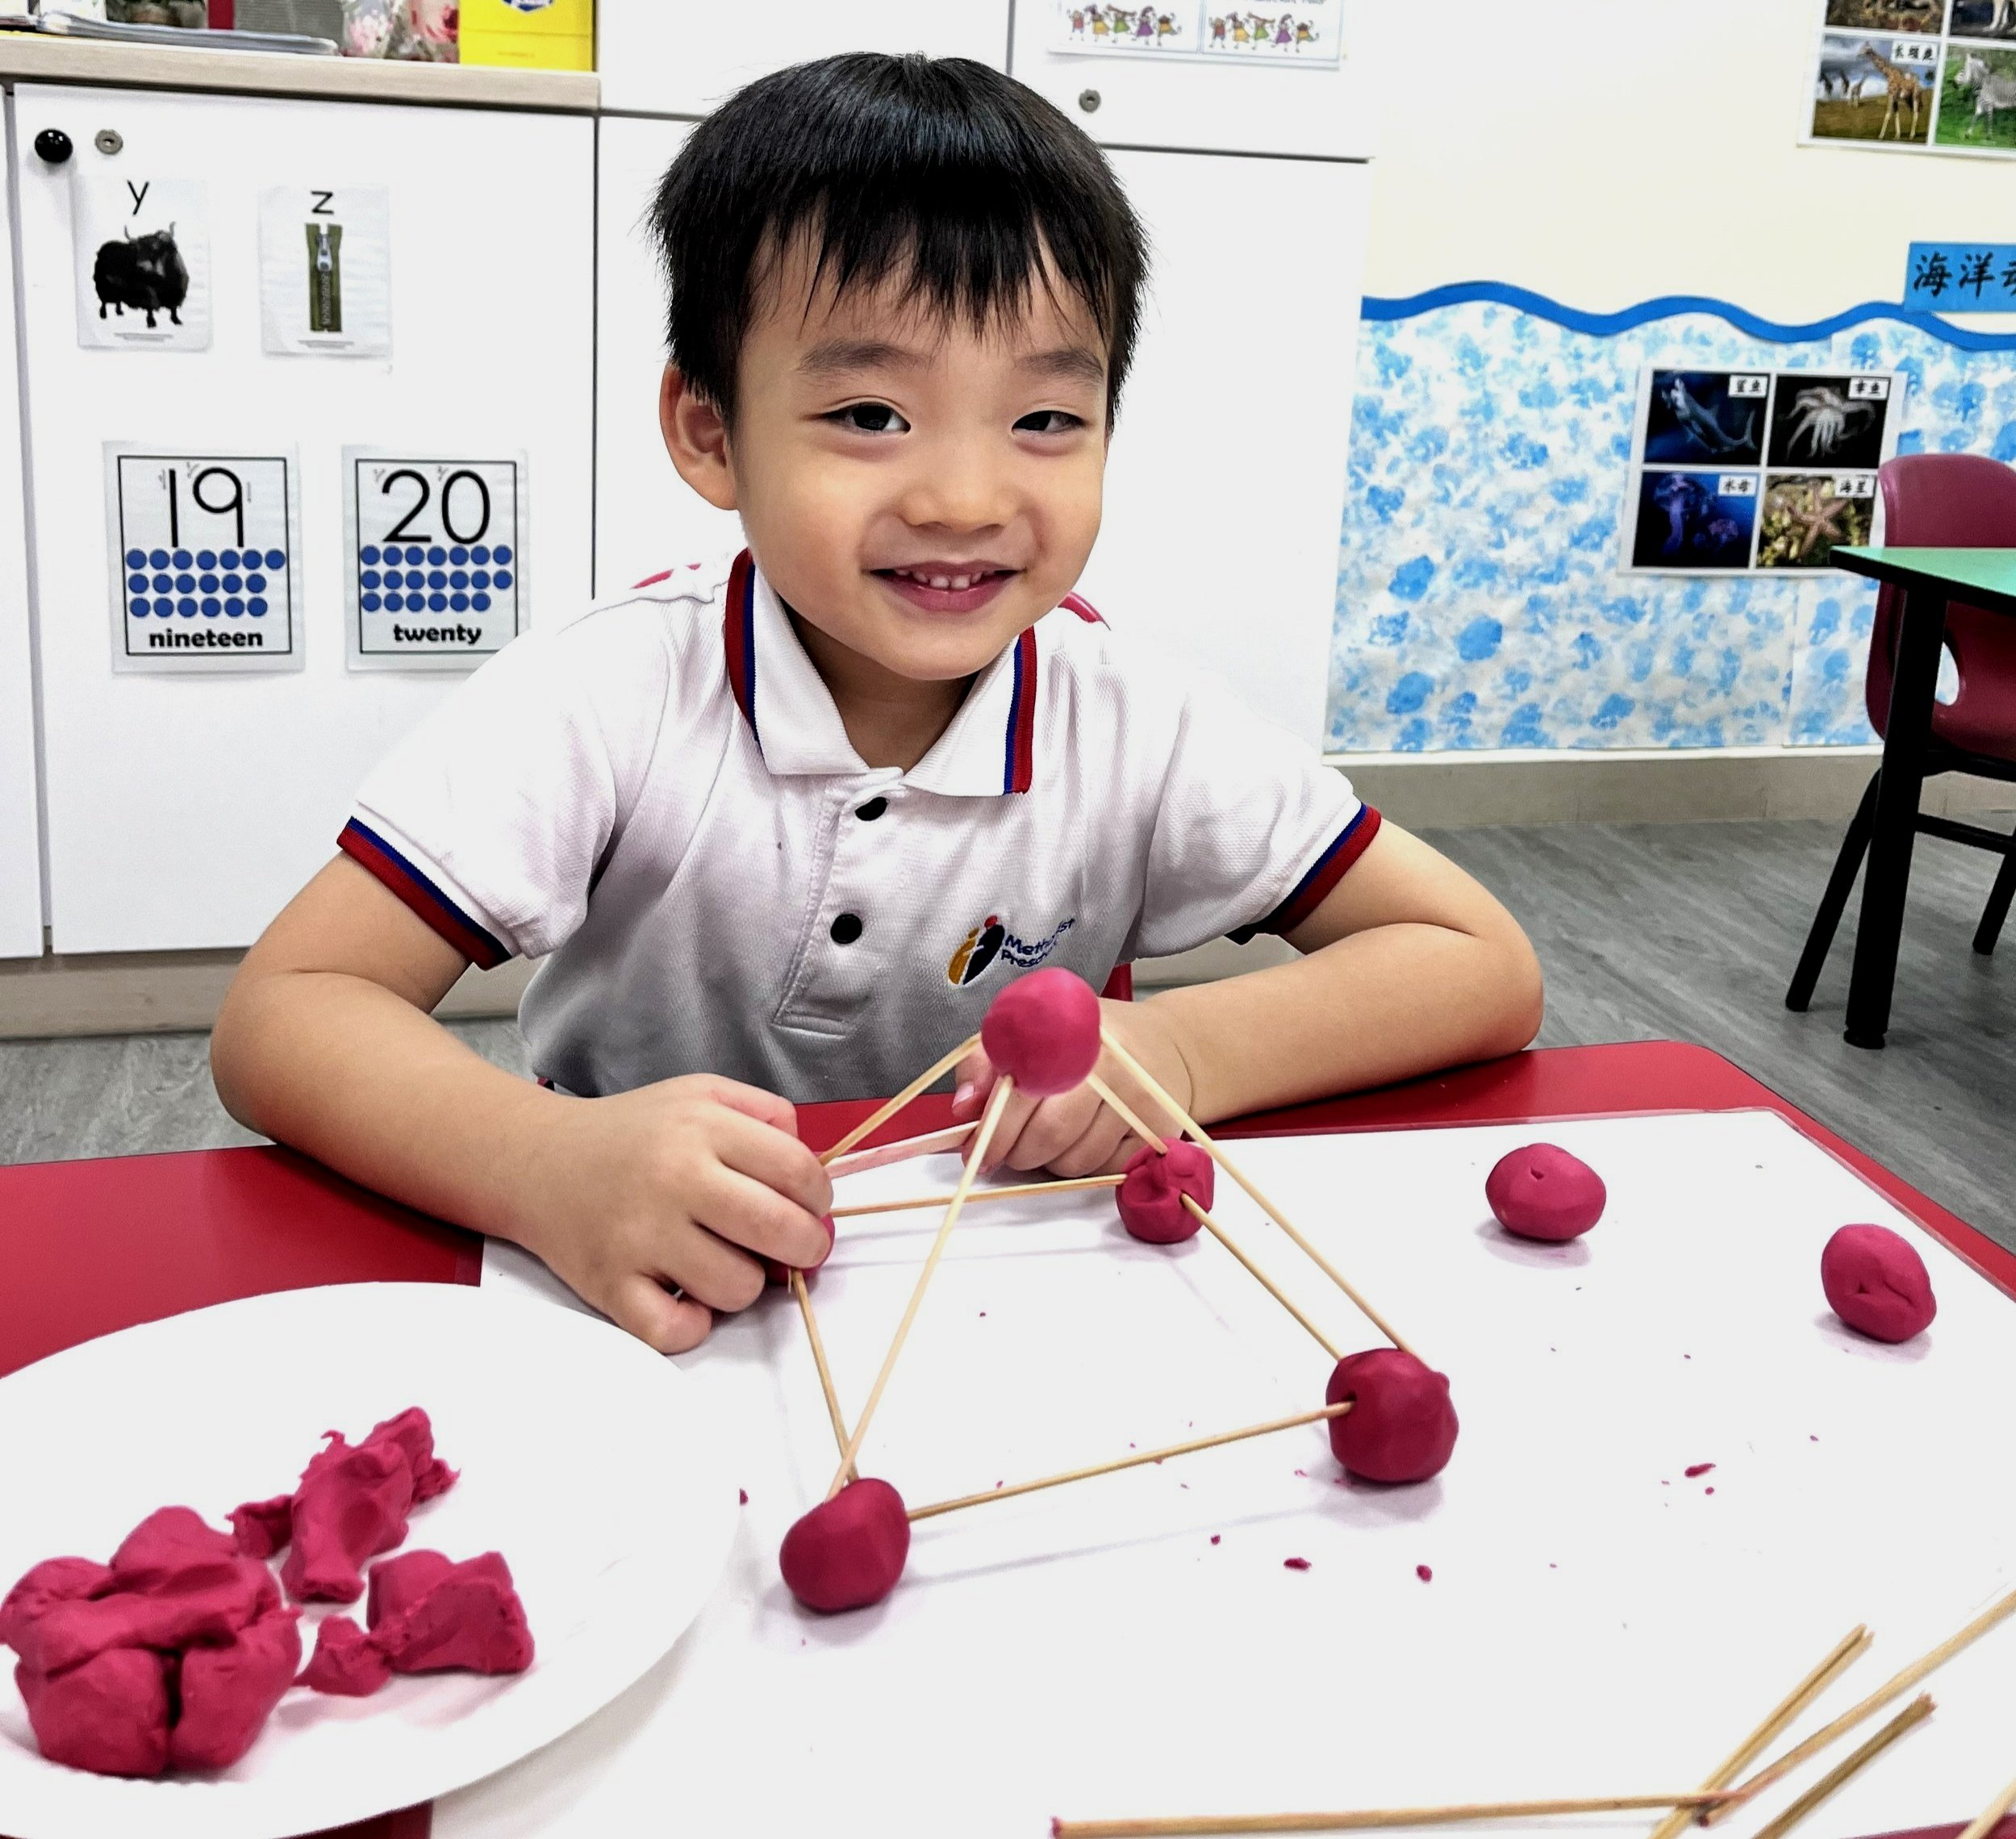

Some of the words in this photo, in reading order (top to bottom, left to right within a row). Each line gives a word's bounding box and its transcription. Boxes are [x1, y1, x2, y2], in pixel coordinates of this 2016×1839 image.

[127, 180, 149, 215] y
[169, 467, 244, 548] 19
[382, 469, 490, 545] 20
[149, 627, 263, 648] nineteen
[393, 623, 482, 645] twenty
